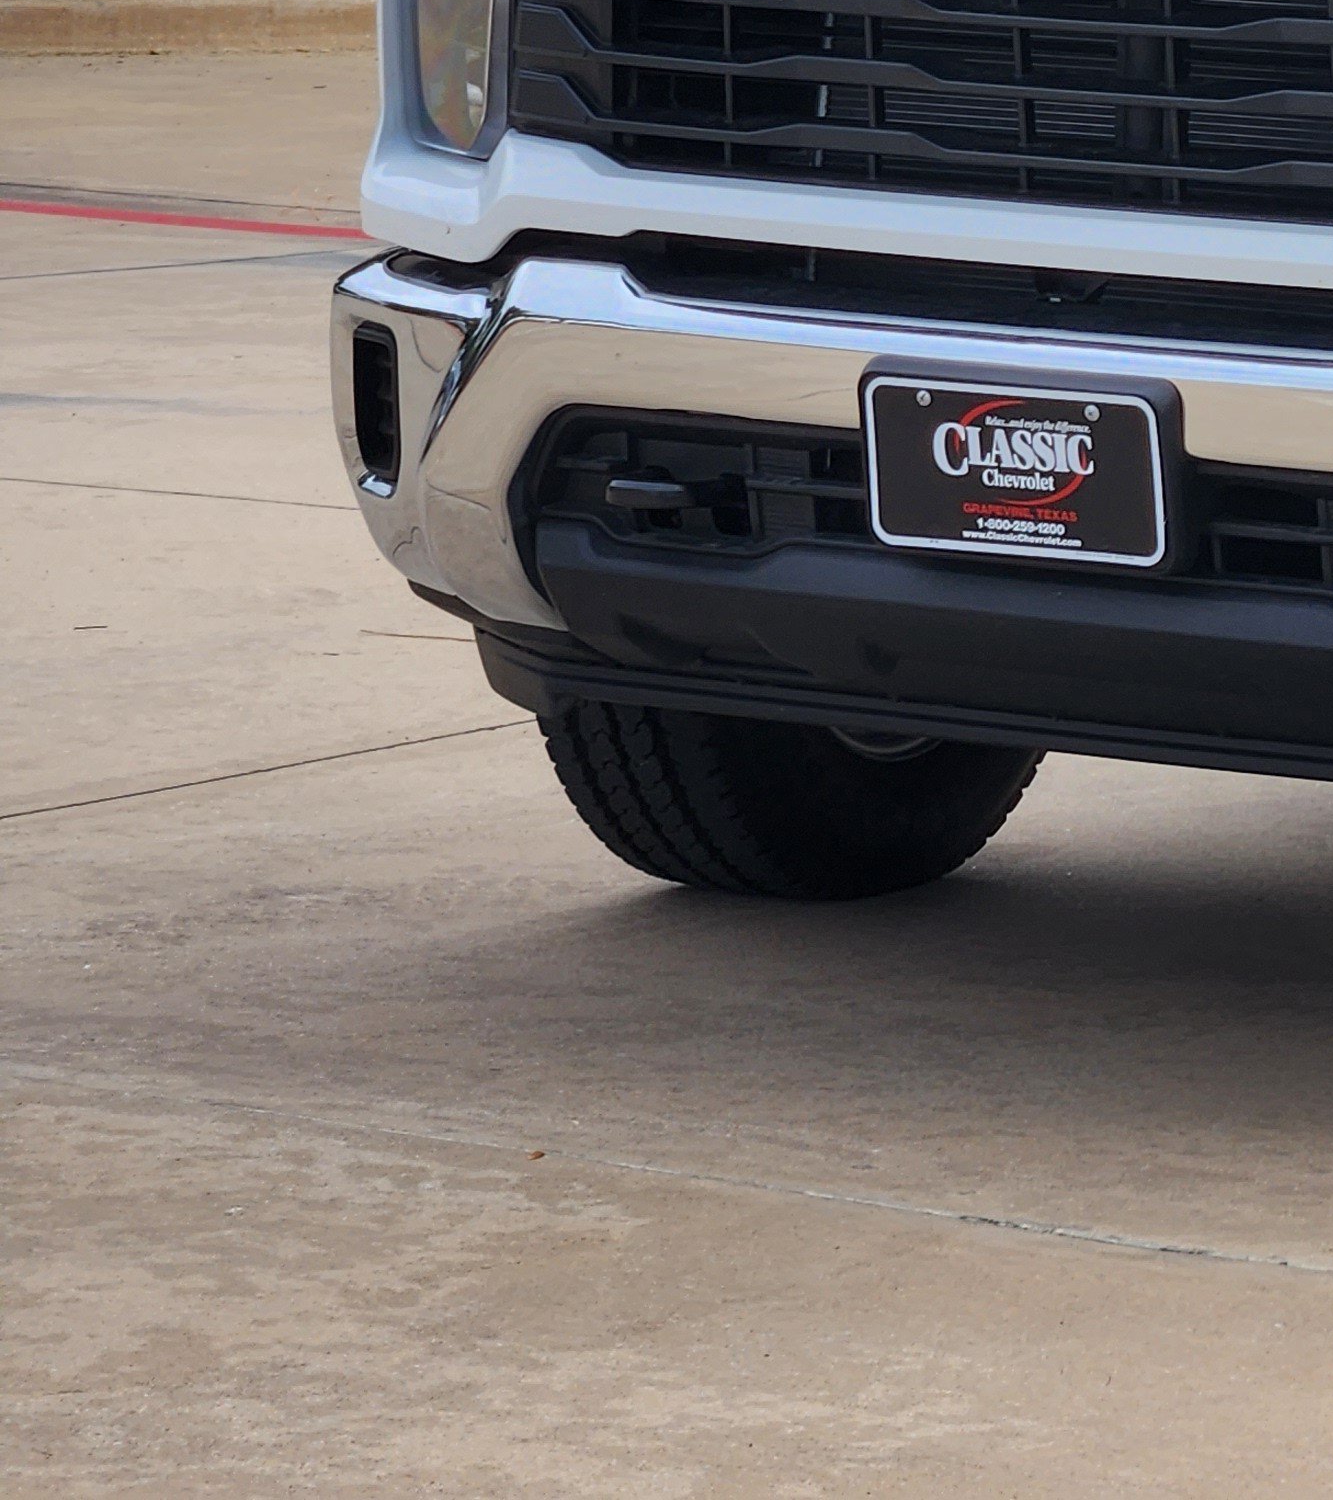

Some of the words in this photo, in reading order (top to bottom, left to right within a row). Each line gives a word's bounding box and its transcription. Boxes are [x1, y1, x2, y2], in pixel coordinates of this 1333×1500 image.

[933, 422, 1094, 476] CLASSIC
[982, 469, 1055, 491] Chevrolet
[1036, 508, 1078, 522] TEXAS
